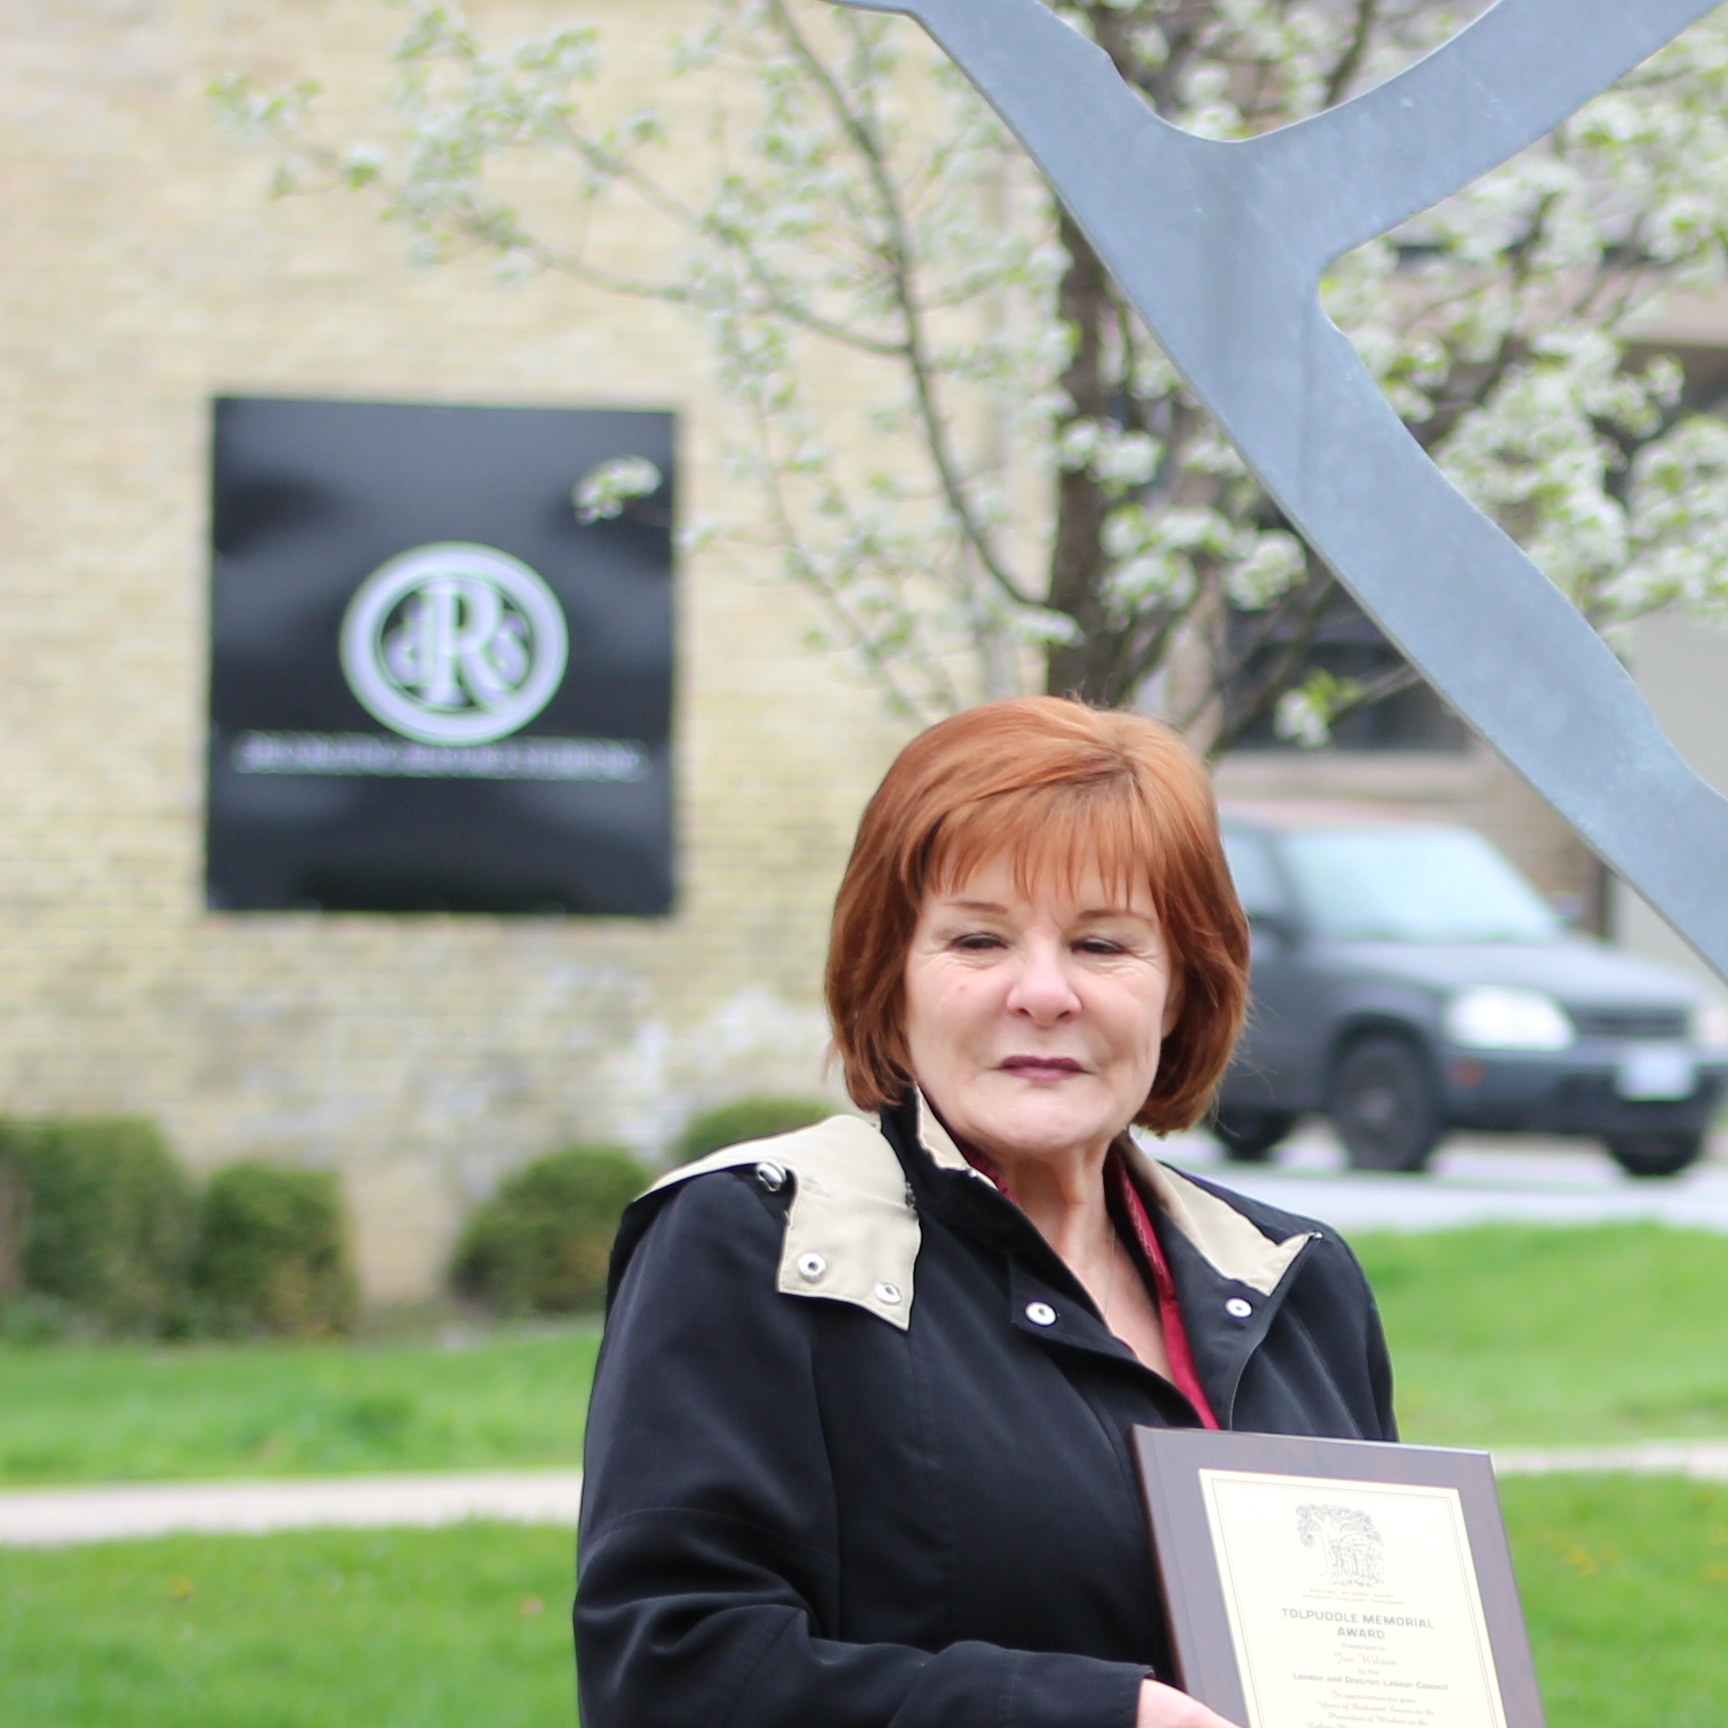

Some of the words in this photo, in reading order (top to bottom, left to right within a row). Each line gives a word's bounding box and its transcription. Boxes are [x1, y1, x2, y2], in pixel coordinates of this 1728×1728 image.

[1281, 1607, 1359, 1623] TOLPUDDLE
[1362, 1614, 1435, 1629] MEMORIAL
[1337, 1627, 1386, 1640] AWARD
[1357, 1653, 1398, 1666] Wilson
[1292, 1672, 1324, 1682] London
[1327, 1675, 1342, 1684] and
[1345, 1676, 1381, 1687] District
[1383, 1679, 1413, 1689] Labour
[1416, 1681, 1449, 1691] Council
